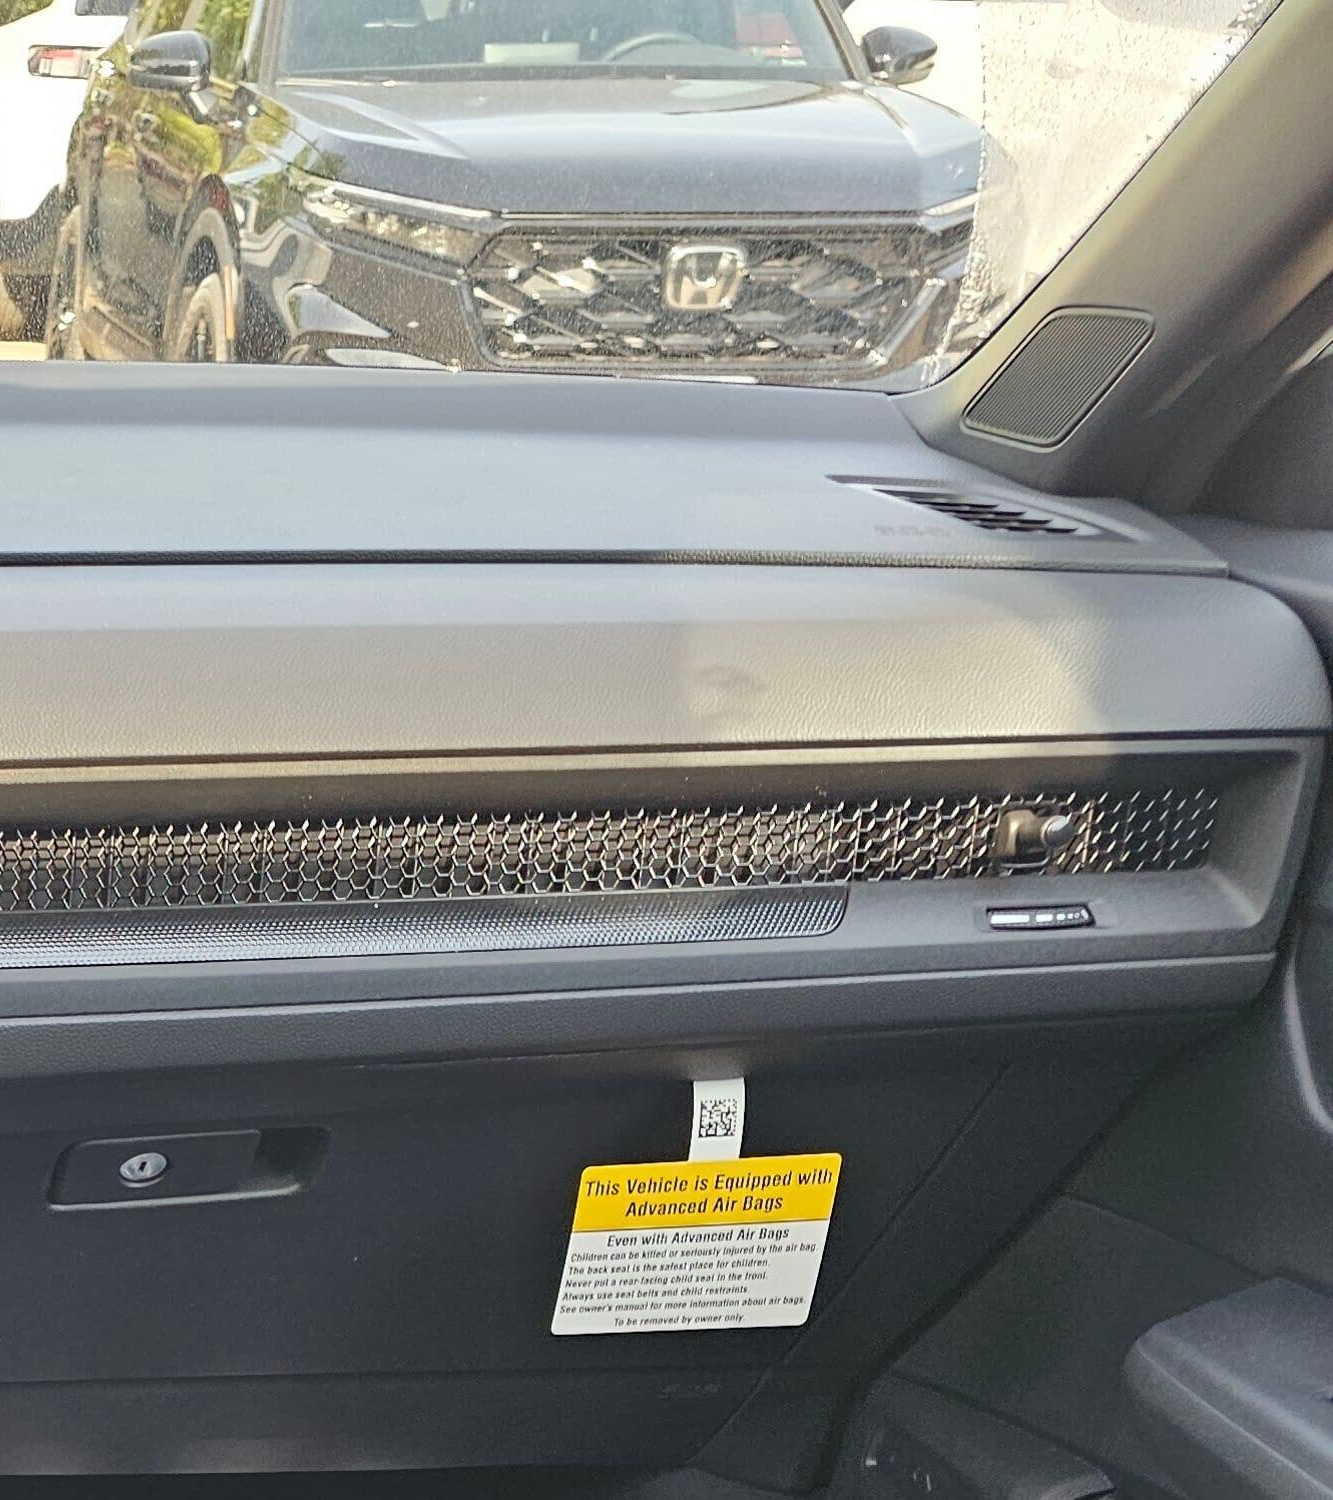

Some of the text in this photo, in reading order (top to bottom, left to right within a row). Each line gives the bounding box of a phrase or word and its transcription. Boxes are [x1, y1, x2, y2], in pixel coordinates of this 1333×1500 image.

[586, 1168, 833, 1196] This Vehicle is Equipped with
[626, 1195, 783, 1217] Advanced Air Bags
[607, 1228, 789, 1247] Even with Advanced Air Bags
[571, 1251, 608, 1262] Children
[628, 1251, 639, 1260] be
[642, 1250, 666, 1259] killed
[669, 1250, 678, 1258] or
[680, 1247, 721, 1258] seriously
[723, 1247, 753, 1257] injured
[756, 1246, 767, 1255] by
[769, 1244, 783, 1253] the
[785, 1244, 797, 1252] air
[569, 1266, 584, 1275] The
[587, 1265, 608, 1274] back
[610, 1265, 630, 1273] seat
[633, 1264, 640, 1272] is
[643, 1263, 657, 1272] the
[659, 1262, 687, 1271] safest
[689, 1261, 713, 1271] place
[716, 1260, 729, 1269] for
[565, 1279, 592, 1288] Never
[594, 1279, 608, 1288] put
[619, 1276, 668, 1286] rear-facing
[670, 1273, 693, 1283] child
[695, 1274, 714, 1282] seat
[717, 1273, 725, 1281] in
[728, 1272, 742, 1281] the
[562, 1292, 593, 1301] Always
[615, 1291, 635, 1299] seat
[637, 1289, 658, 1298] belts
[661, 1288, 678, 1297] and
[680, 1286, 702, 1296] child
[560, 1305, 576, 1314] See
[579, 1304, 613, 1313] owner's
[615, 1303, 648, 1312] manual
[650, 1302, 662, 1311] for
[664, 1301, 687, 1309] more
[690, 1298, 740, 1308] information
[742, 1297, 766, 1306] about
[769, 1297, 781, 1305] air
[614, 1318, 624, 1327] To
[627, 1317, 637, 1326] be
[640, 1316, 678, 1325] removed
[681, 1315, 691, 1325] by
[695, 1315, 722, 1323] owner
